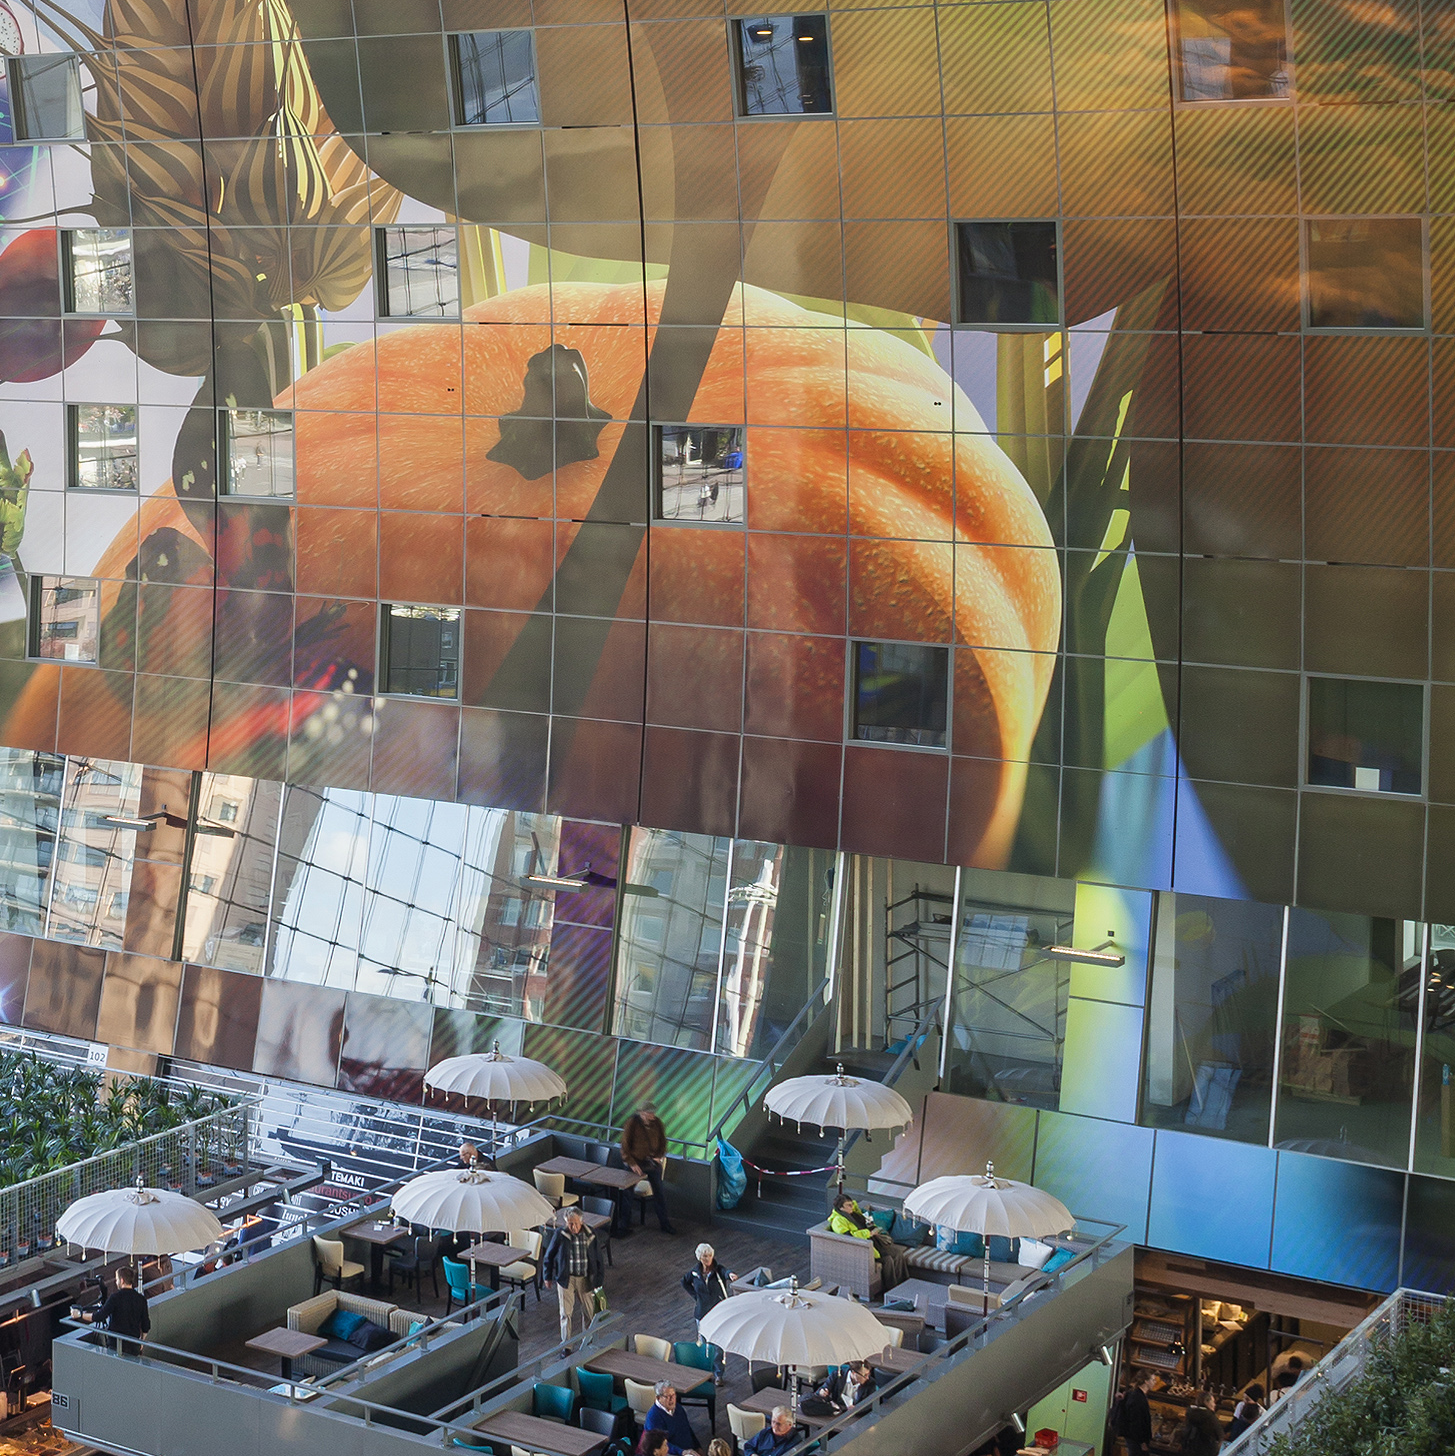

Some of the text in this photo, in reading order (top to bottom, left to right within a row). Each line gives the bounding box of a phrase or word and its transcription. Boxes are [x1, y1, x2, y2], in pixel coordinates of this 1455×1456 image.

[89, 1050, 106, 1063] 102
[331, 1171, 365, 1187] TEMAKI
[52, 1393, 68, 1408] 86
